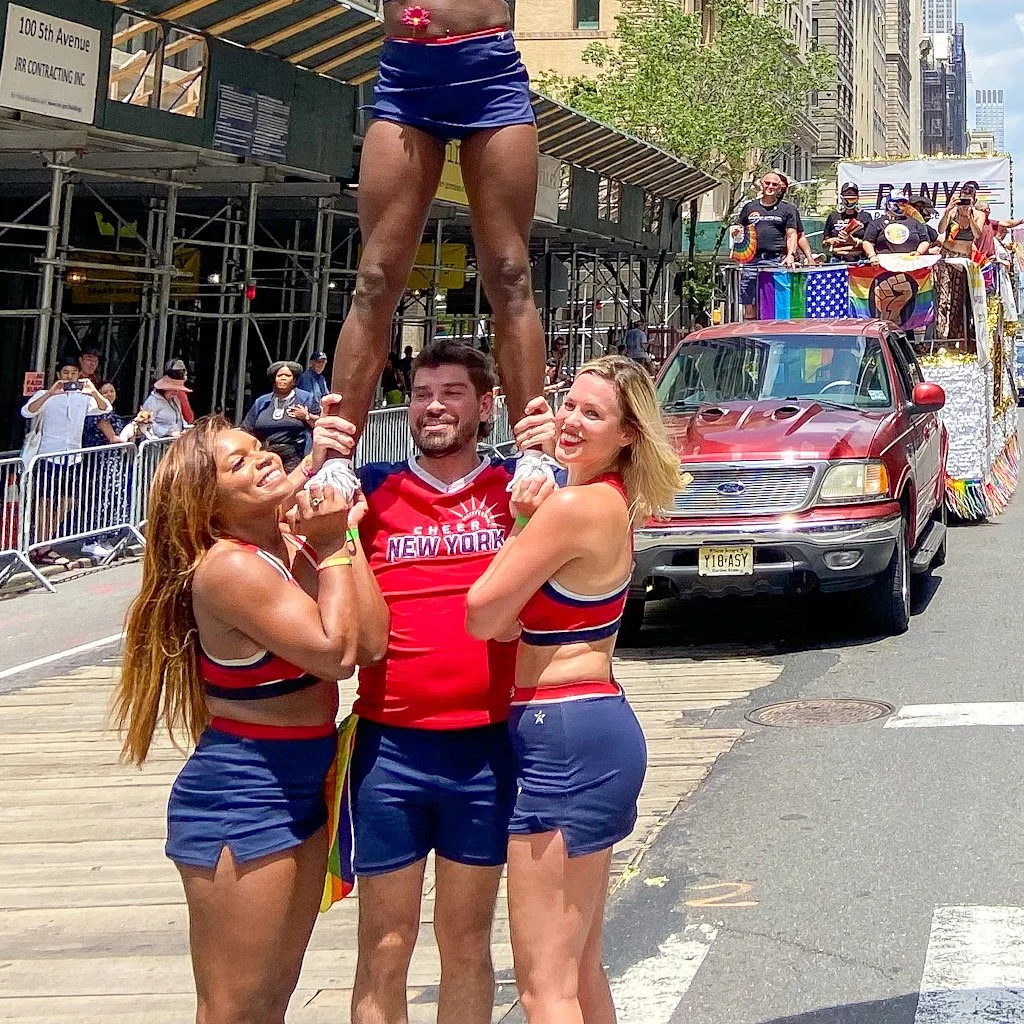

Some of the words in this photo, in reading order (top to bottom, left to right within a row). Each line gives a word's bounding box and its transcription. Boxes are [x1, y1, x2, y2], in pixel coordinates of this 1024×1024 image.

[19, 16, 37, 37] 100
[38, 22, 54, 43] 5th
[55, 27, 91, 53] Avenue
[27, 60, 74, 85] CONTRACTING
[413, 520, 481, 536] CHEER
[386, 536, 441, 563] NEW
[444, 528, 505, 556] YORK
